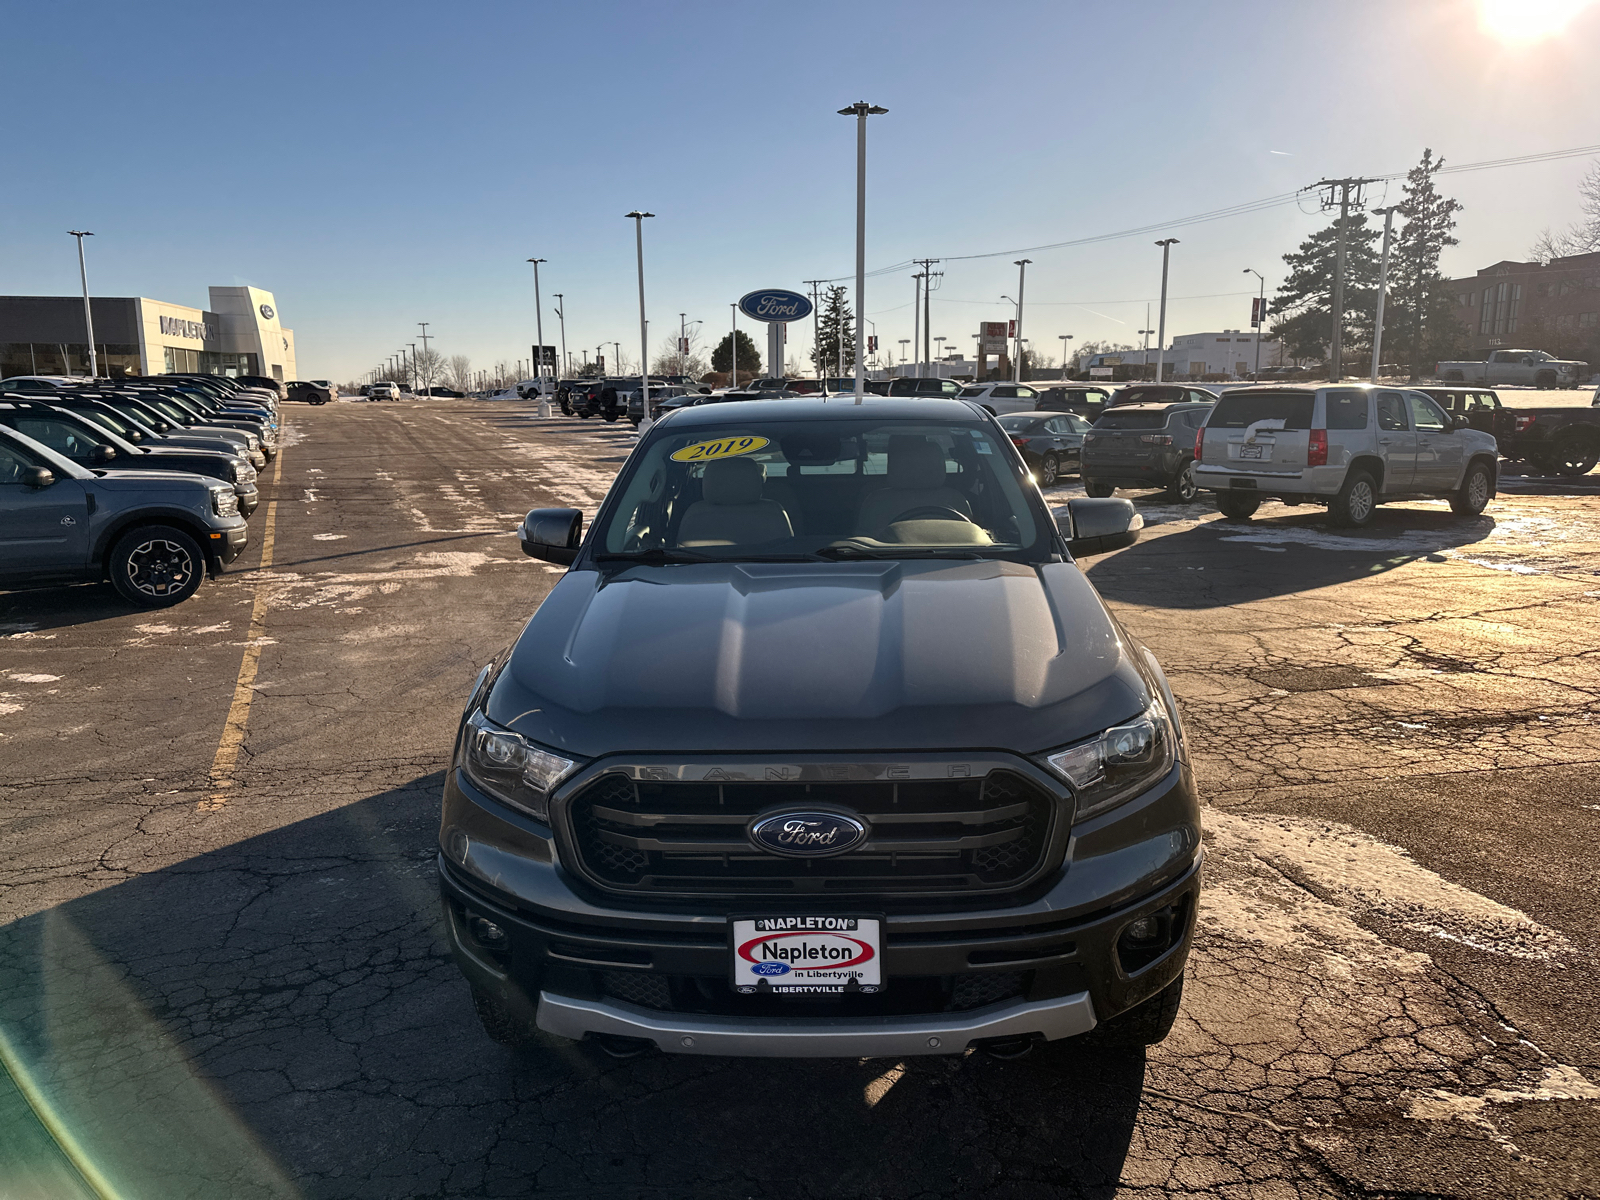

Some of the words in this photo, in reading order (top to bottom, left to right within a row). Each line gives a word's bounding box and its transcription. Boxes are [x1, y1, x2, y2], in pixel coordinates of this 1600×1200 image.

[757, 295, 799, 315] Ford
[159, 315, 215, 341] NAPLETON
[688, 438, 754, 459] 2019
[645, 763, 971, 781] RANGER
[778, 820, 838, 845] Ford
[763, 917, 848, 930] NAPLETON
[762, 942, 853, 964] Napleton
[759, 964, 783, 975] Ford
[807, 971, 864, 980] Libertyville
